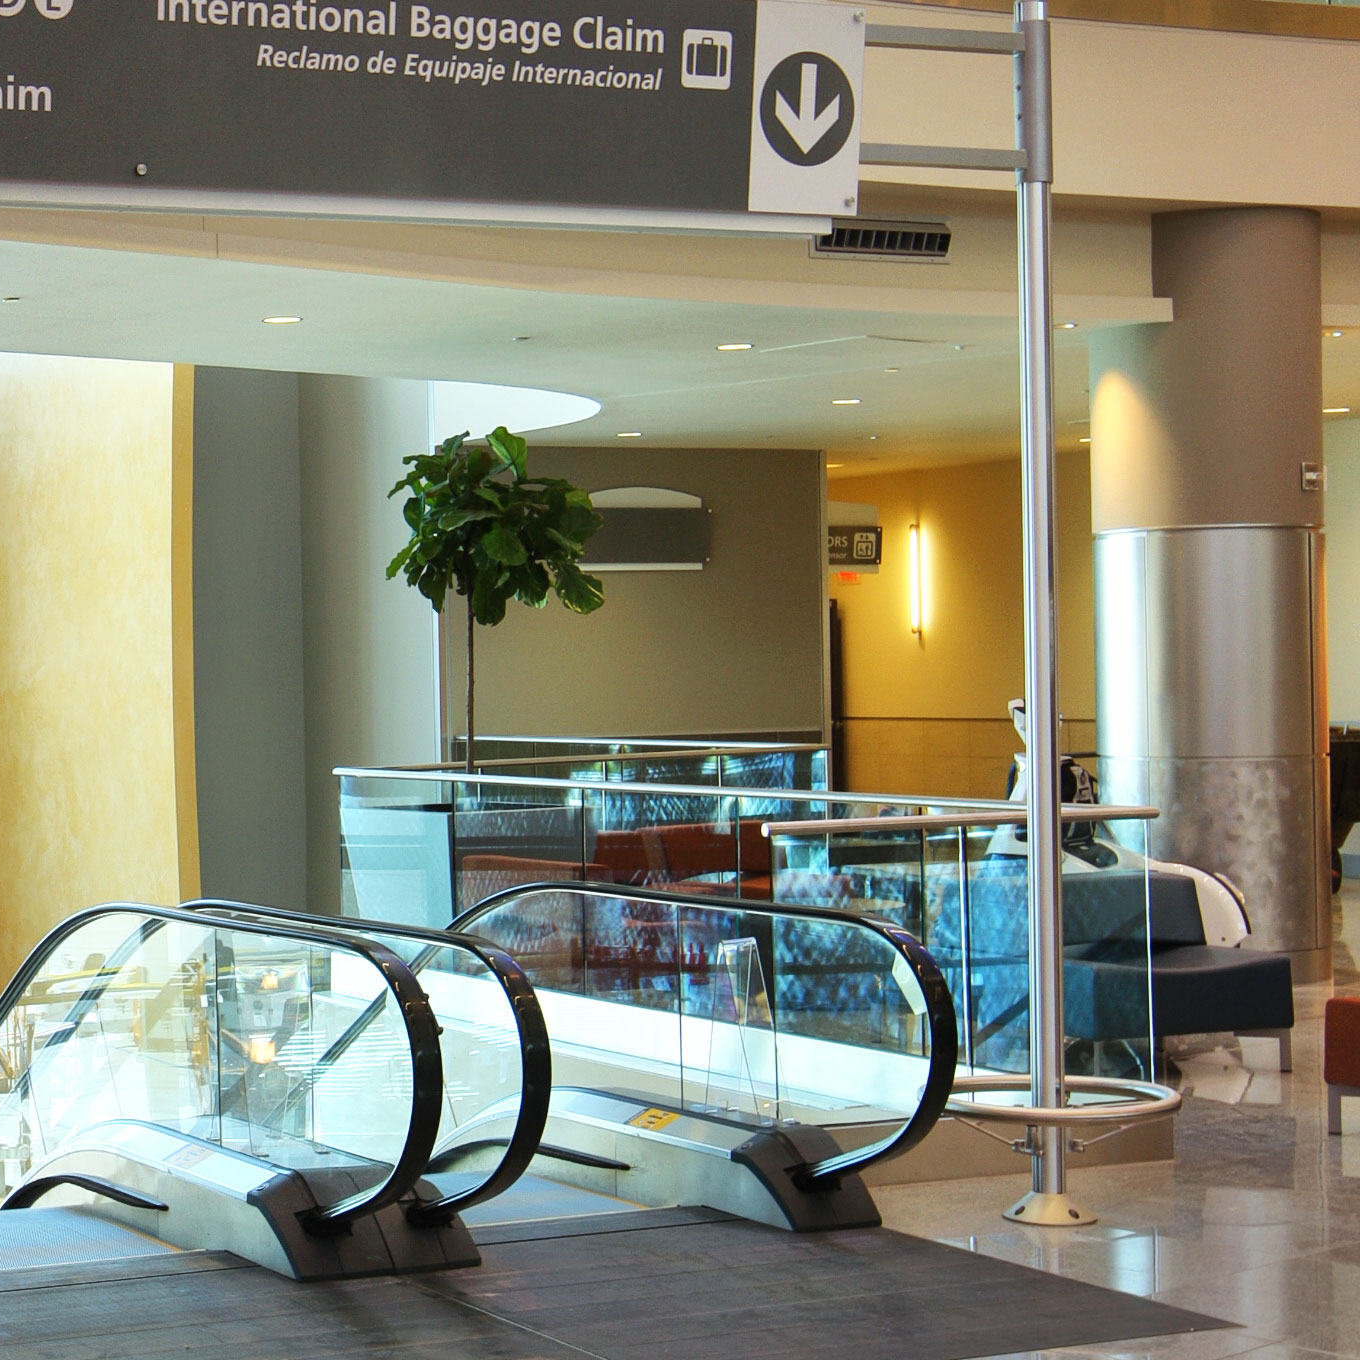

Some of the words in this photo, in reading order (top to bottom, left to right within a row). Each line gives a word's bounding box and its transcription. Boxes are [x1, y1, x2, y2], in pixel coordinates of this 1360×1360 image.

[410, 5, 562, 54] Baggage
[573, 15, 665, 54] Claim
[256, 44, 360, 72] Reclamo
[366, 50, 397, 75] de
[404, 53, 506, 86] Equipaje
[512, 60, 663, 90] Internacional
